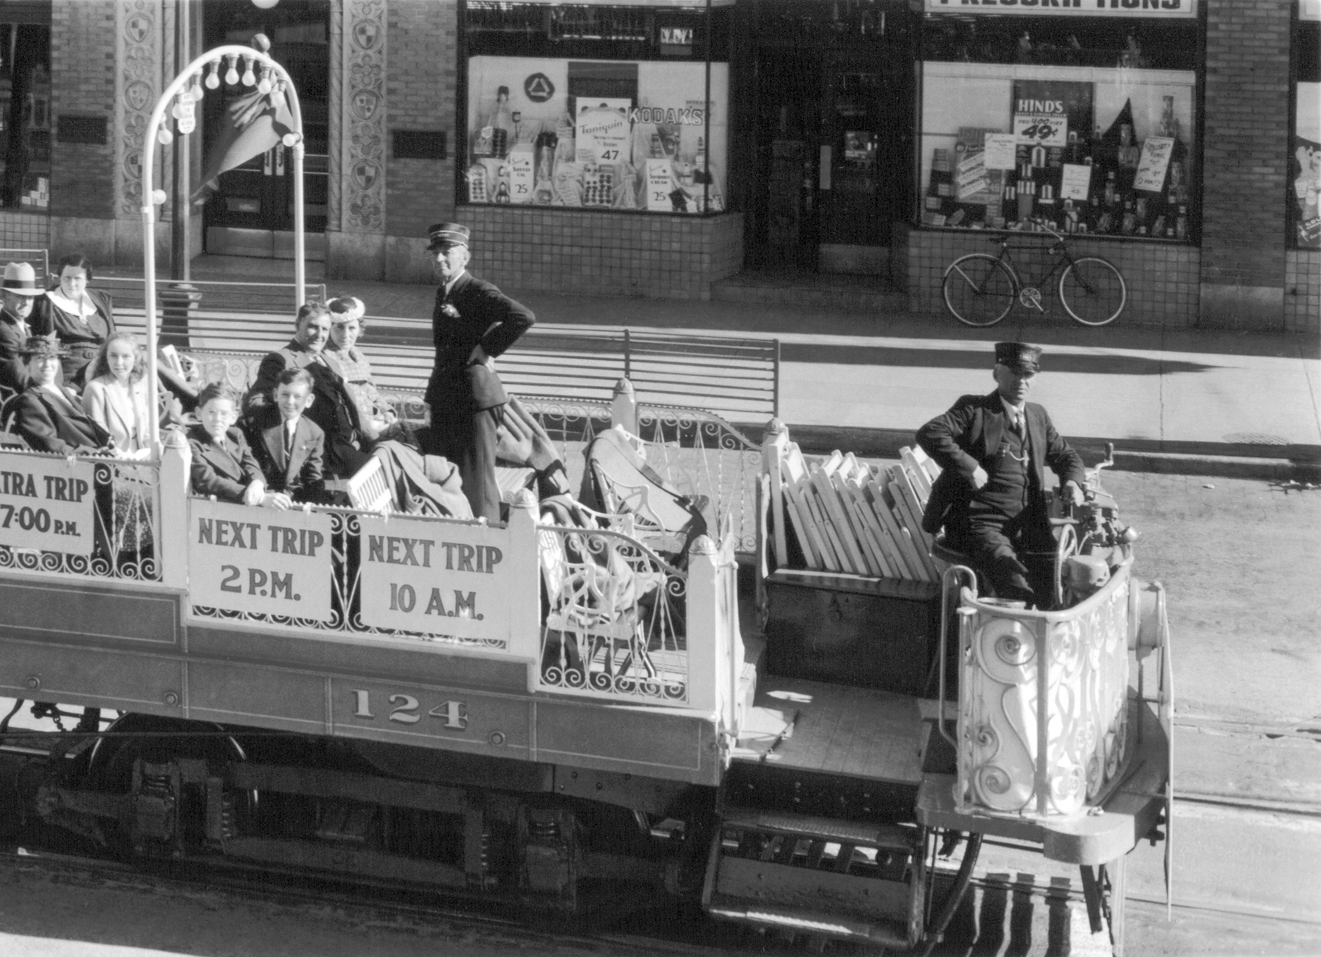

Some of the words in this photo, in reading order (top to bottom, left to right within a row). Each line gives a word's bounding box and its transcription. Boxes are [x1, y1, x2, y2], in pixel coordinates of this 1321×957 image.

[1018, 99, 1064, 113] HINDS
[601, 150, 619, 160] 47
[515, 184, 528, 194] 25
[653, 192, 666, 201] 25
[43, 475, 89, 503] TRIP
[0, 503, 51, 533] 7:00
[53, 519, 81, 537] P.M.
[198, 517, 261, 550] NEXT
[267, 525, 324, 557] TRIP
[368, 534, 435, 568] NEXT
[441, 541, 503, 574] TRIP
[220, 564, 242, 593] 2
[247, 567, 301, 601] P.M.
[389, 582, 416, 613] 10
[424, 587, 484, 620] A.M.
[351, 688, 469, 731] 124
